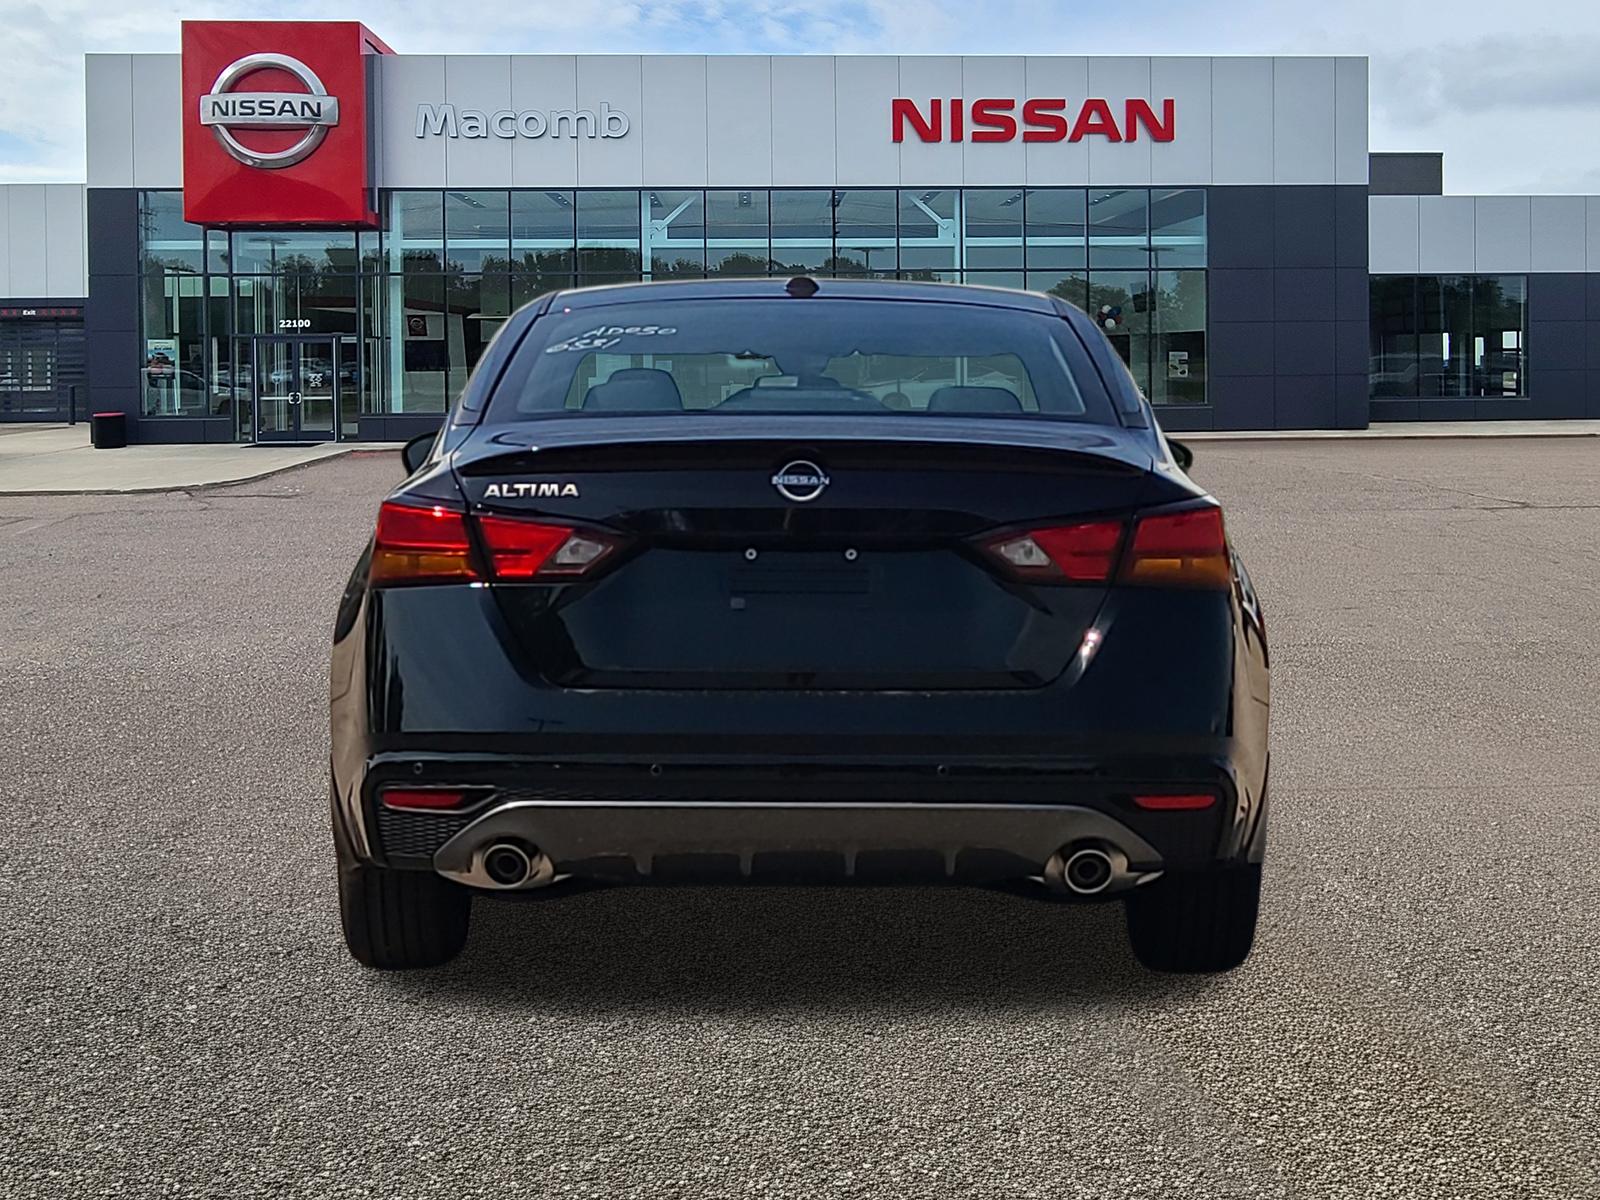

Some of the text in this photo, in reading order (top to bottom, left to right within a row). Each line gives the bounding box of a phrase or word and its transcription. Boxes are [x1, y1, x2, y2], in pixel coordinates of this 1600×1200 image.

[211, 100, 322, 118] NISSAN
[415, 102, 630, 139] Macomb
[892, 98, 1175, 143] NISSAN
[279, 319, 311, 328] 22100
[771, 474, 830, 485] NISSAN
[483, 483, 580, 498] ALTIMA
